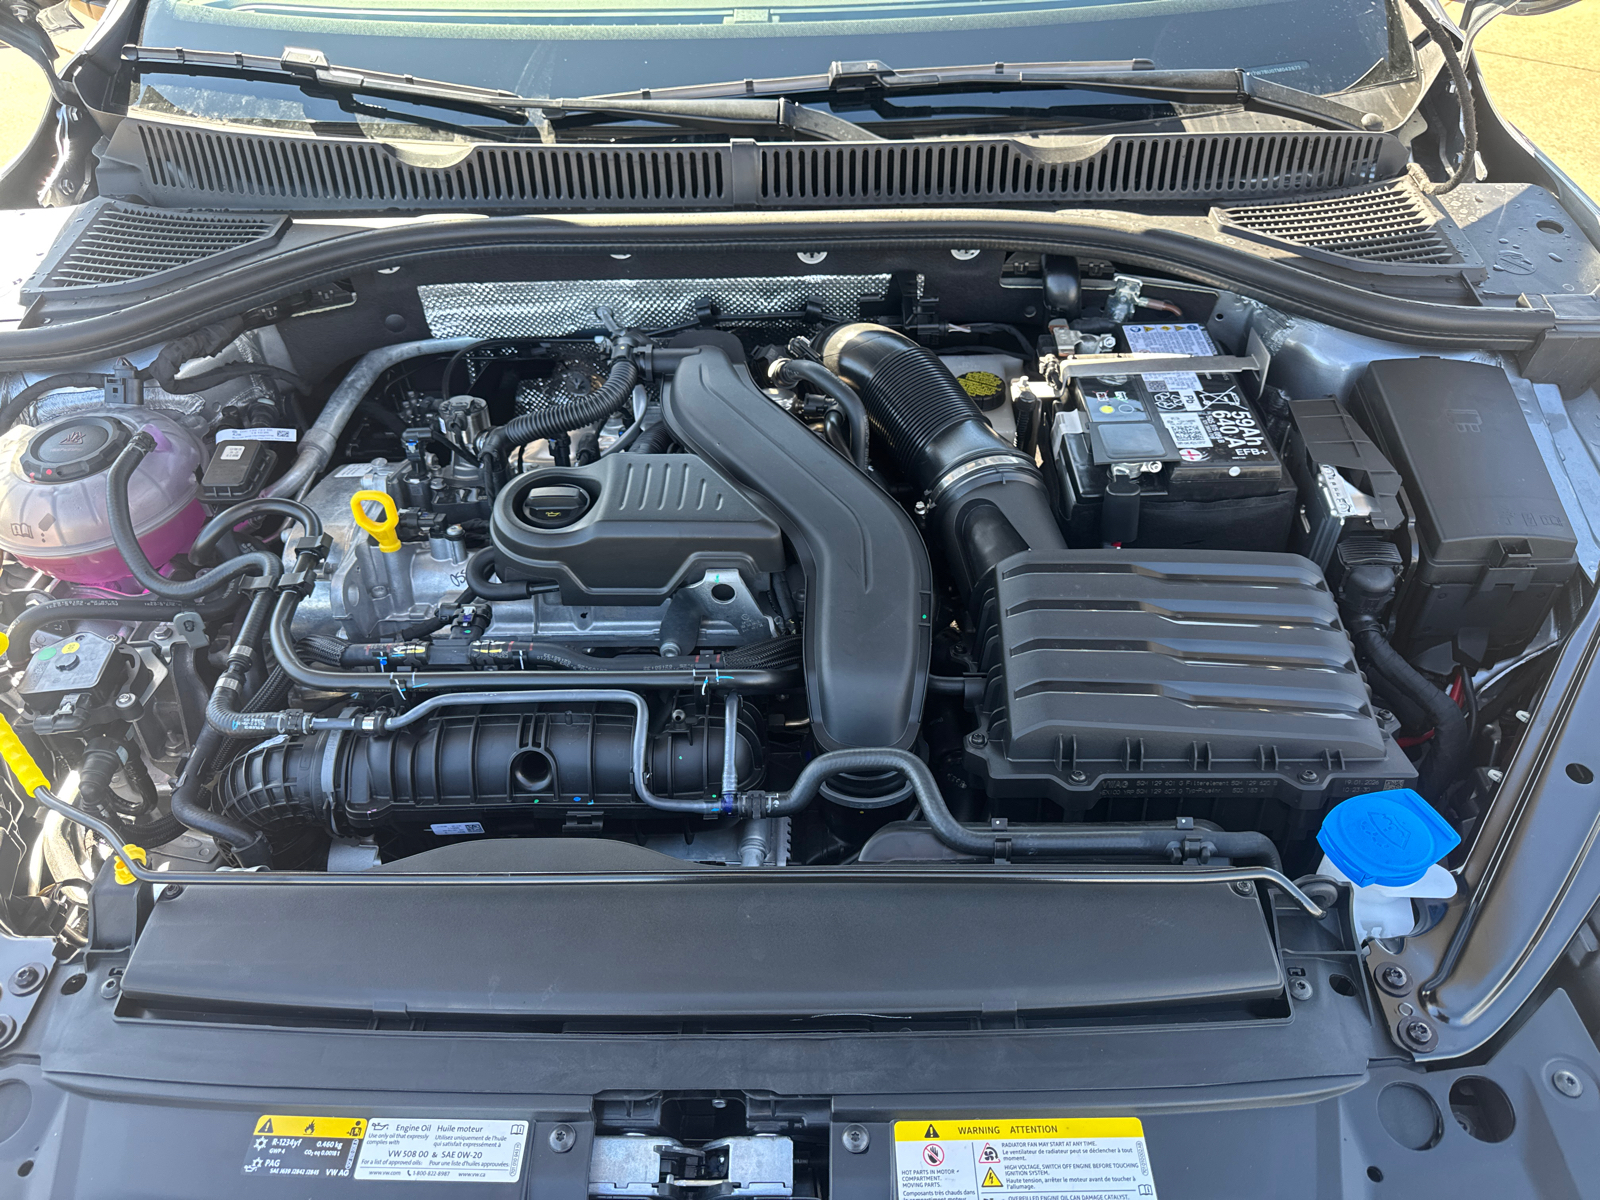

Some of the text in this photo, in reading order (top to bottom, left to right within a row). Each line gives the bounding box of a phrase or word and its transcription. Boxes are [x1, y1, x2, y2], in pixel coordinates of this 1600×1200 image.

[1183, 394, 1194, 404] Pb
[1212, 410, 1240, 434] 640
[1231, 411, 1265, 445] 59Ah
[1223, 436, 1247, 448] A
[1235, 448, 1269, 456] EFB+
[396, 1124, 420, 1133] Engine
[421, 1124, 431, 1132] Oil
[436, 1125, 456, 1133] Huile
[958, 1126, 1000, 1135] WARNING
[1009, 1124, 1058, 1134] ATTENTION
[271, 1138, 303, 1149] R-1234yf
[335, 1141, 343, 1150] kg
[462, 1141, 497, 1149] expressément
[388, 1150, 402, 1158] VW
[402, 1150, 417, 1158] 508
[418, 1150, 429, 1158] 00
[441, 1151, 456, 1159] SAE
[457, 1151, 483, 1159] 0W-20
[264, 1159, 281, 1167] PAG
[388, 1159, 412, 1167] approved
[338, 1169, 350, 1177] AG
[902, 1190, 934, 1198] Composants
